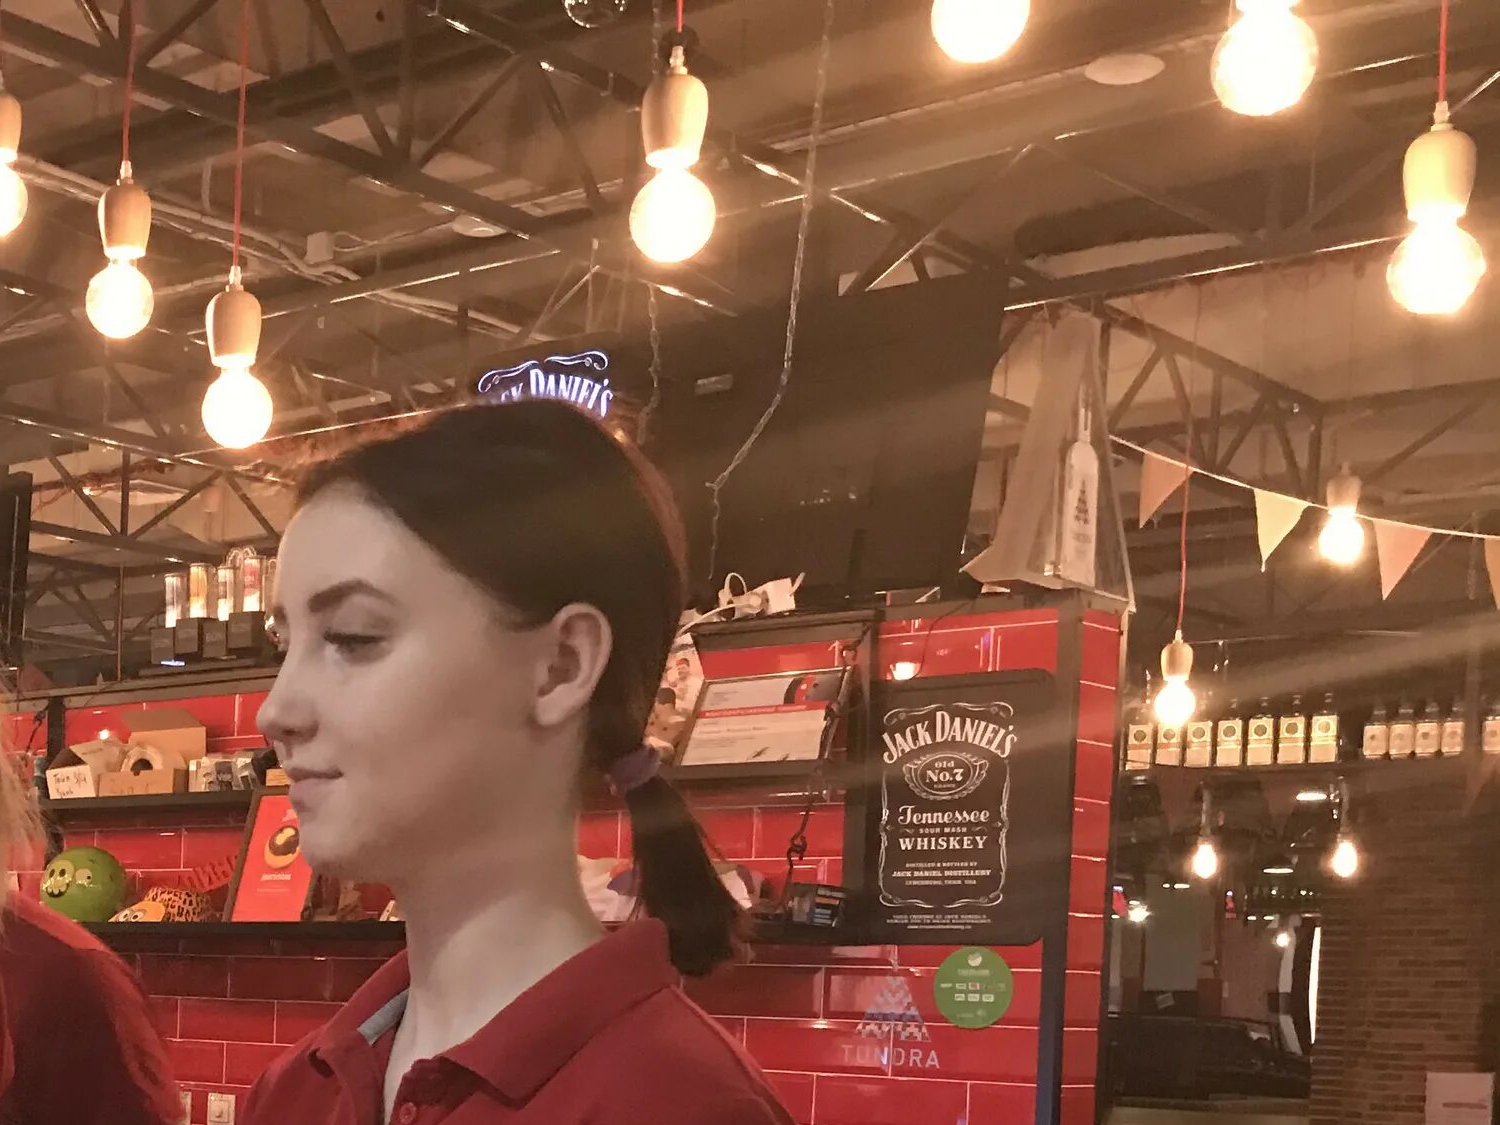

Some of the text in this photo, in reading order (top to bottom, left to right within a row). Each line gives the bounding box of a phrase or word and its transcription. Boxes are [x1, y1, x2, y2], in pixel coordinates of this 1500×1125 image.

[881, 710, 1018, 764] JACK DANIEL'S
[897, 804, 990, 825] Tennessee
[898, 835, 988, 851] WHISKEY
[840, 1044, 941, 1070] TUNDRA
